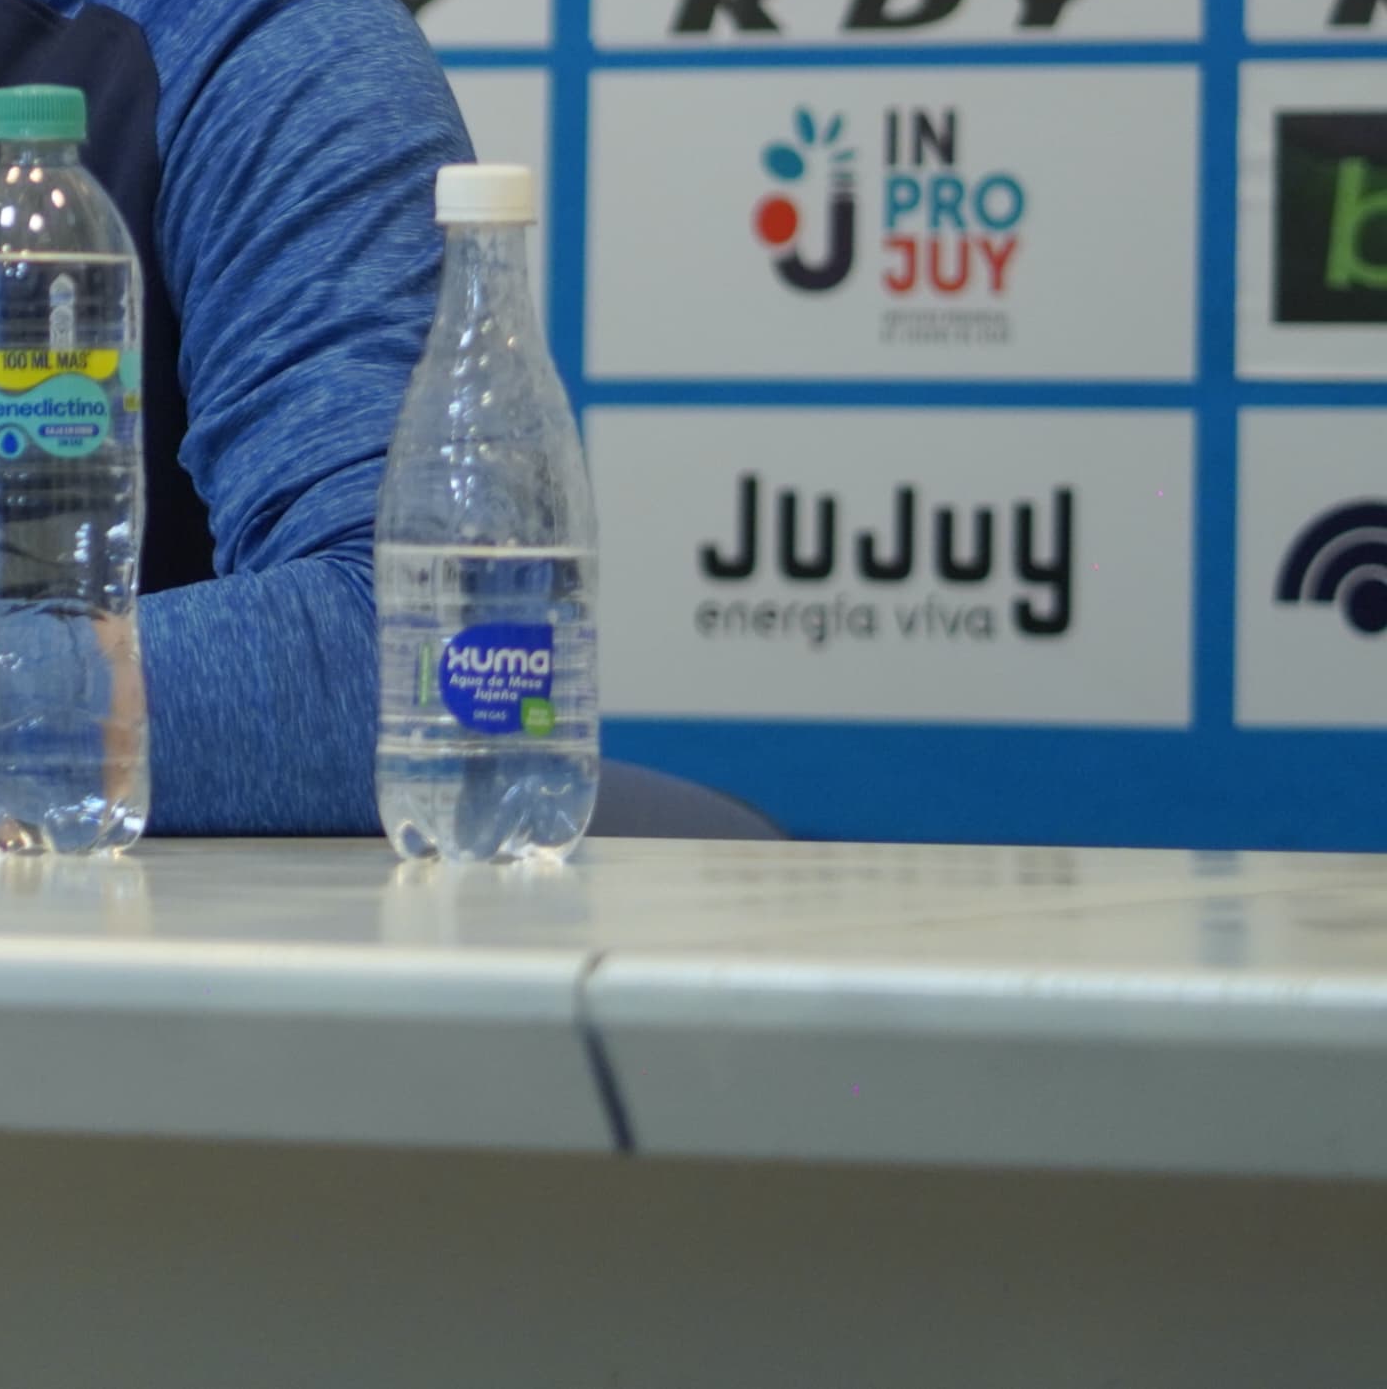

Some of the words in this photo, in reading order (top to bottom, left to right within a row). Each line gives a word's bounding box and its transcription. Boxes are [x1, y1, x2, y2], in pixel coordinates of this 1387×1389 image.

[884, 108, 958, 167] IN
[884, 173, 1026, 231] PRO
[883, 234, 1018, 295] JUY
[894, 589, 996, 640] viva
[449, 672, 484, 689] Agua
[487, 674, 504, 687] de
[508, 676, 543, 689] Mesa
[473, 687, 518, 703] Jujeña
